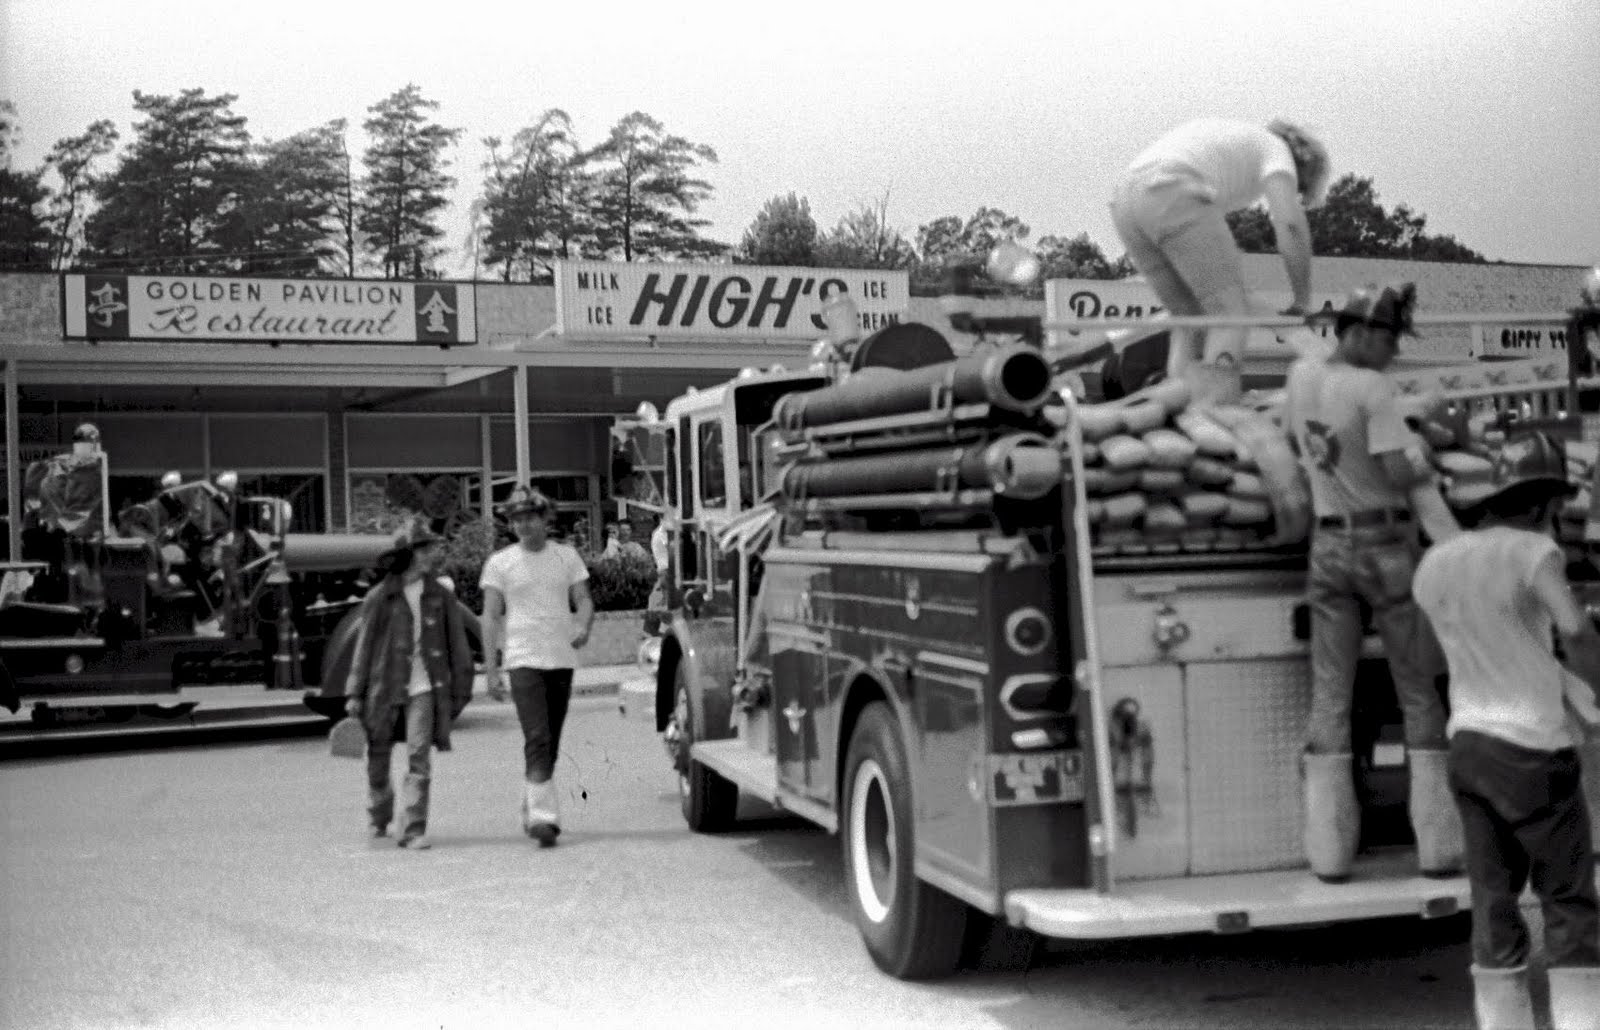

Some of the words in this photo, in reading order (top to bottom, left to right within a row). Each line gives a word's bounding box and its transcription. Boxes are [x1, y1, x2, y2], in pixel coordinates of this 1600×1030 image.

[577, 272, 619, 290] MILK
[863, 281, 888, 299] ICE
[146, 281, 261, 301] GOLDEN
[282, 284, 402, 304] PAVILION
[629, 273, 848, 328] HIGH'S
[148, 304, 398, 334] Restaurant
[588, 306, 613, 325] ICE
[857, 312, 899, 331] REAM
